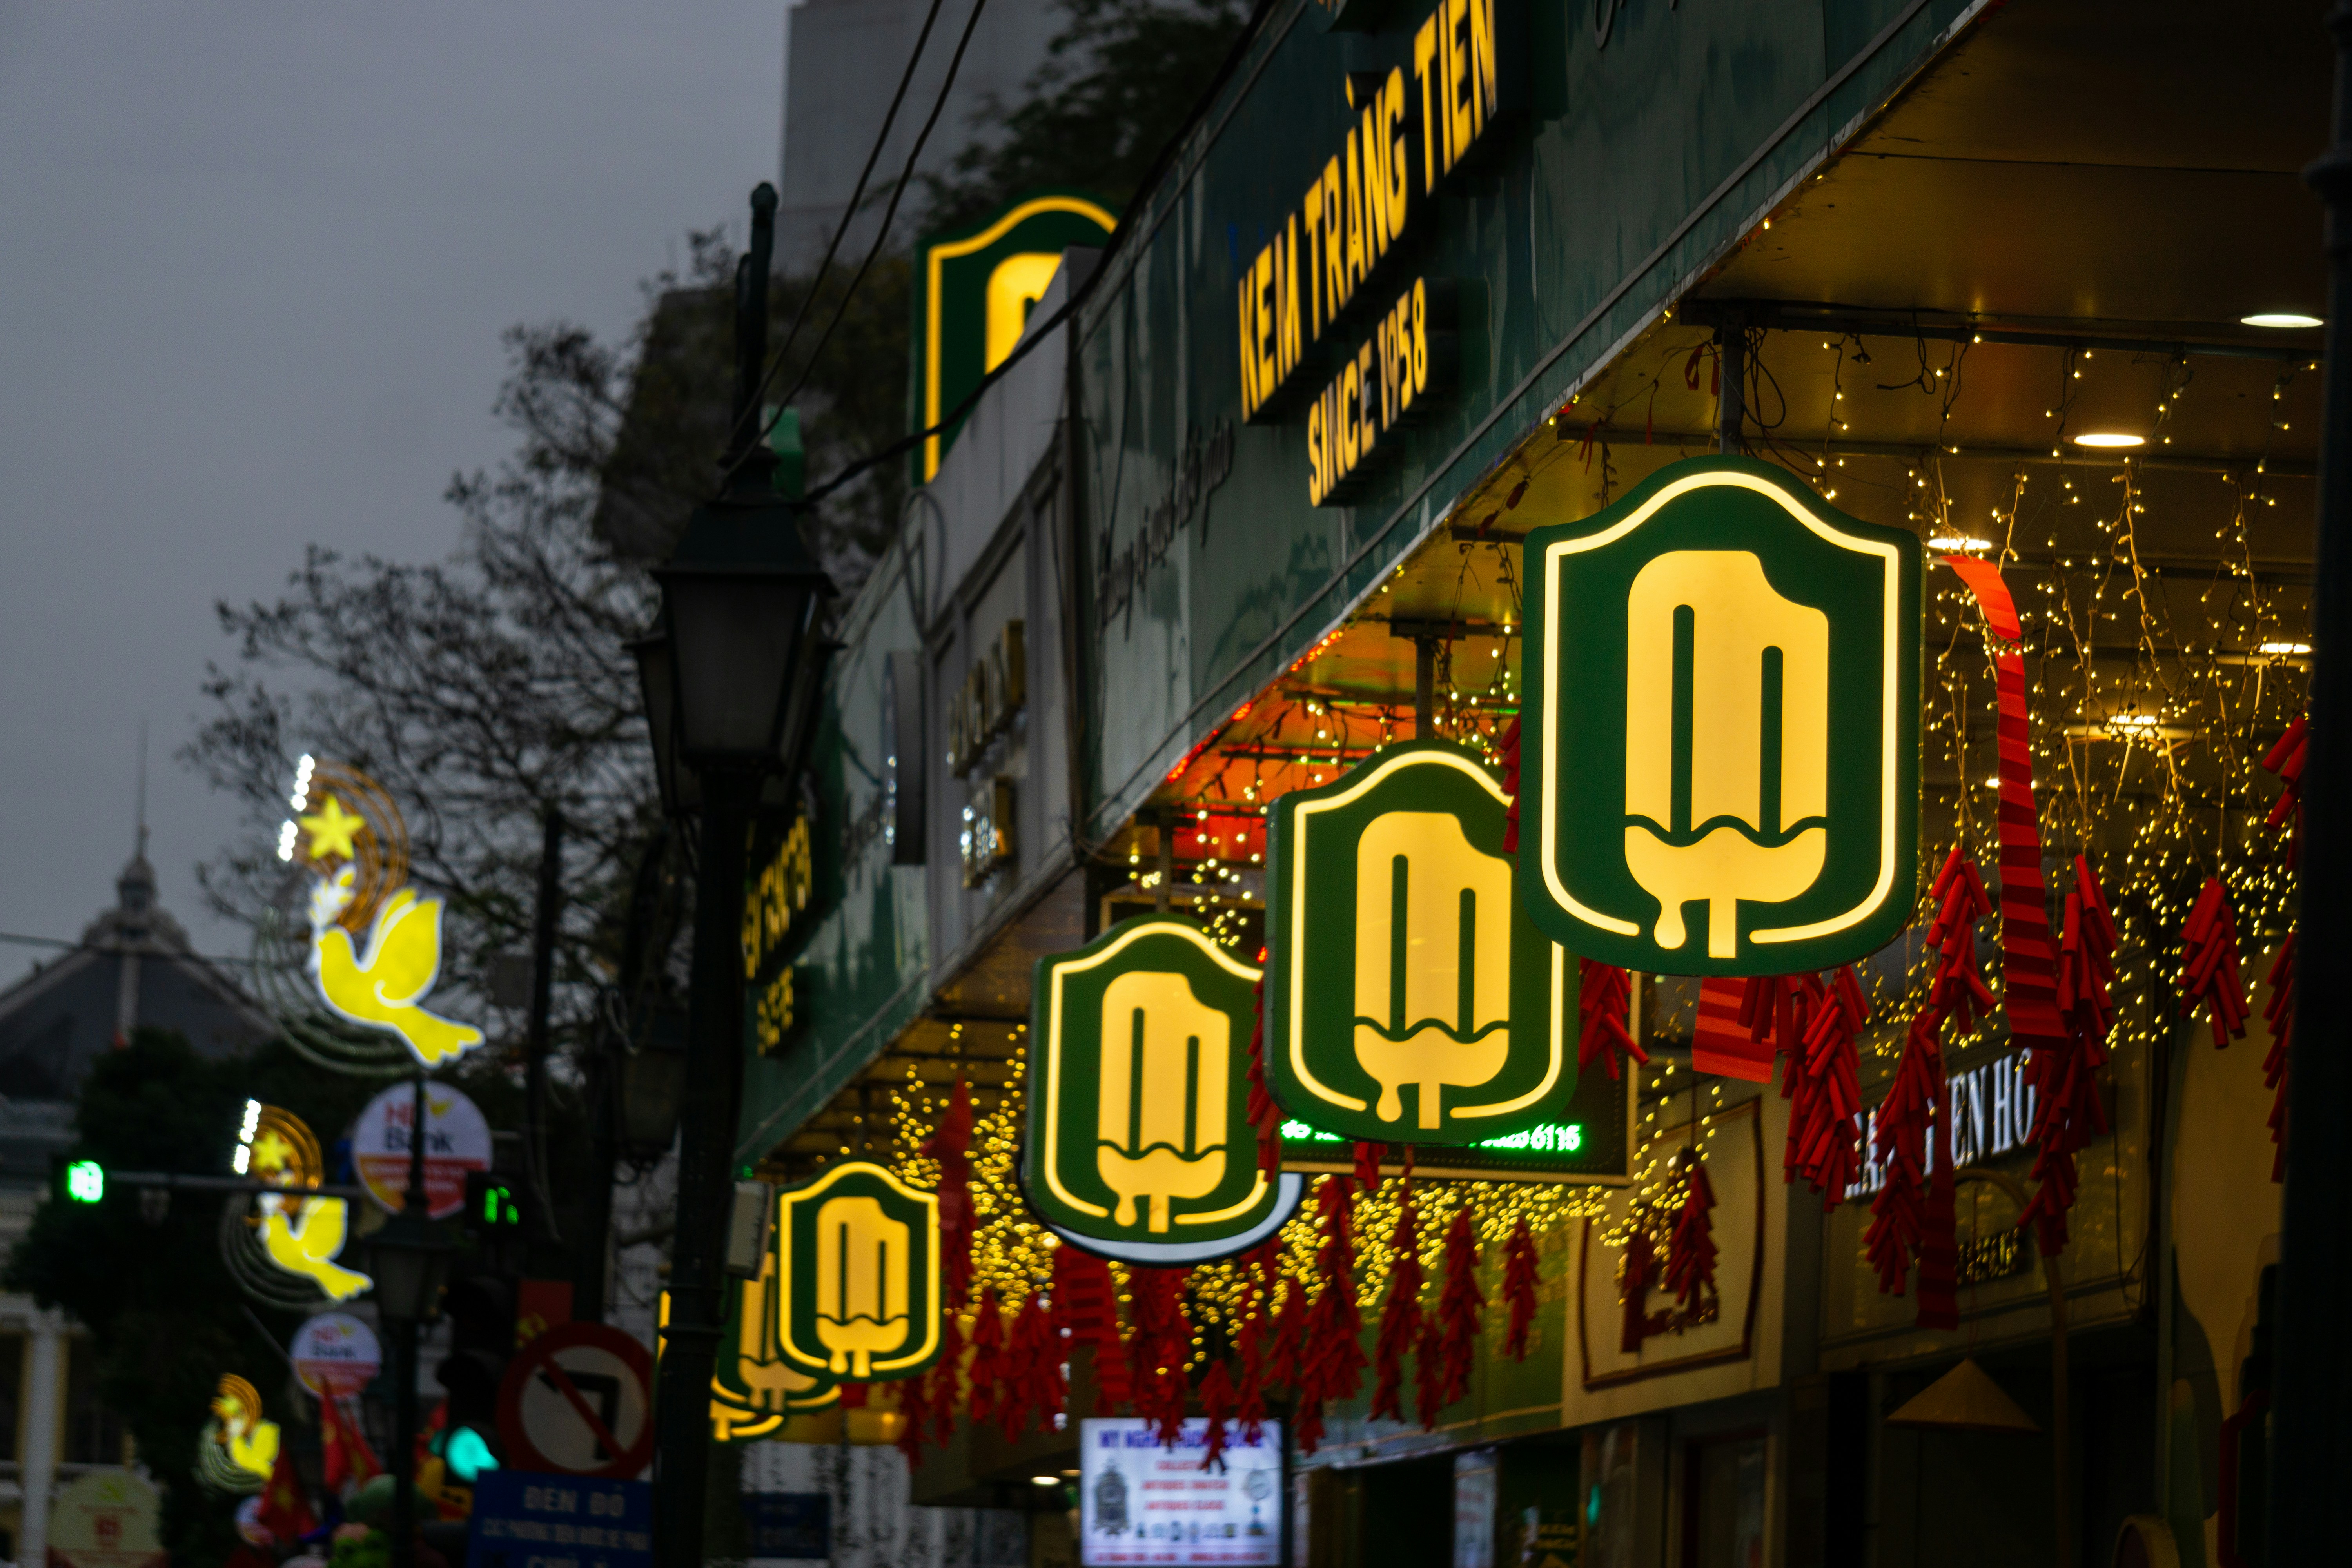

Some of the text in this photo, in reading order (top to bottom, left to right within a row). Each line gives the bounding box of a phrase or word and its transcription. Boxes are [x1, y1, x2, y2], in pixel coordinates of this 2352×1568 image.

[1239, 213, 1301, 423] KEM
[1308, 276, 1428, 507] SINCE 1958
